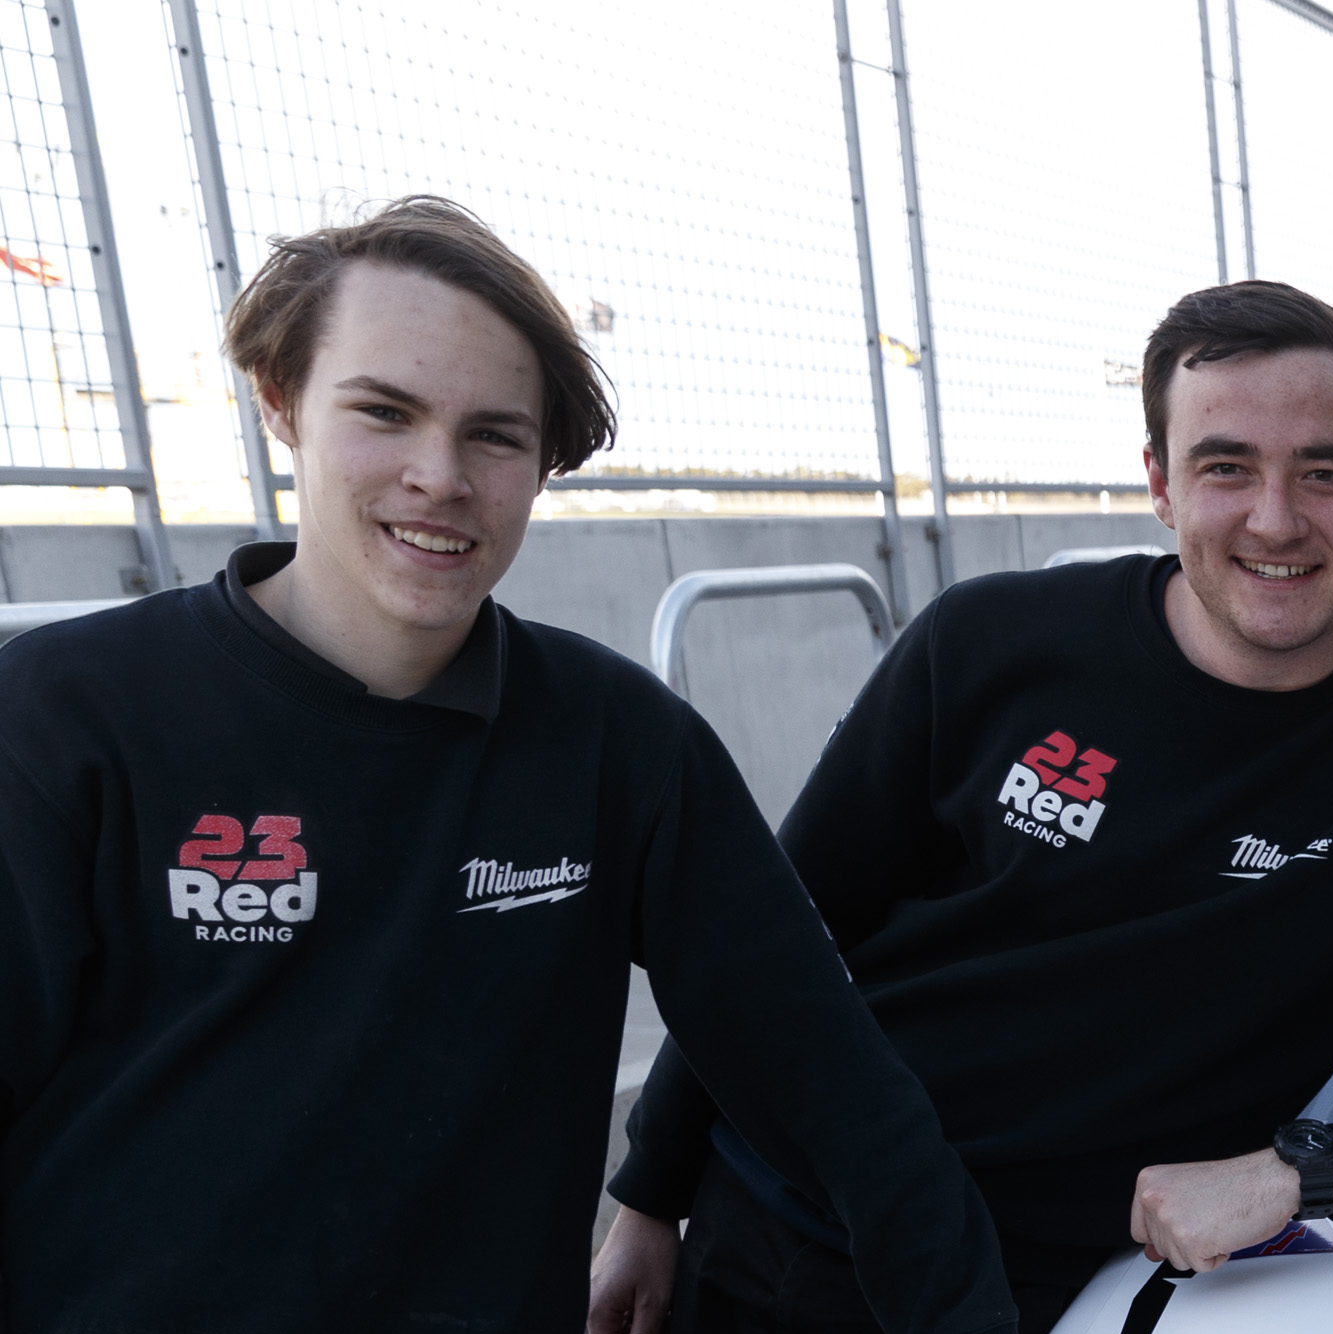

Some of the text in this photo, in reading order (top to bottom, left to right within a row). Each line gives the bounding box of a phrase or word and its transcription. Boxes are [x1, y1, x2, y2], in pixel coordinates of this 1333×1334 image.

[1021, 730, 1118, 802] 23
[997, 762, 1106, 843] Red
[1003, 811, 1067, 848] RACING
[179, 814, 307, 881] 23
[168, 868, 318, 922] Red
[458, 857, 592, 900] Milwaukee
[195, 925, 293, 943] RACING
